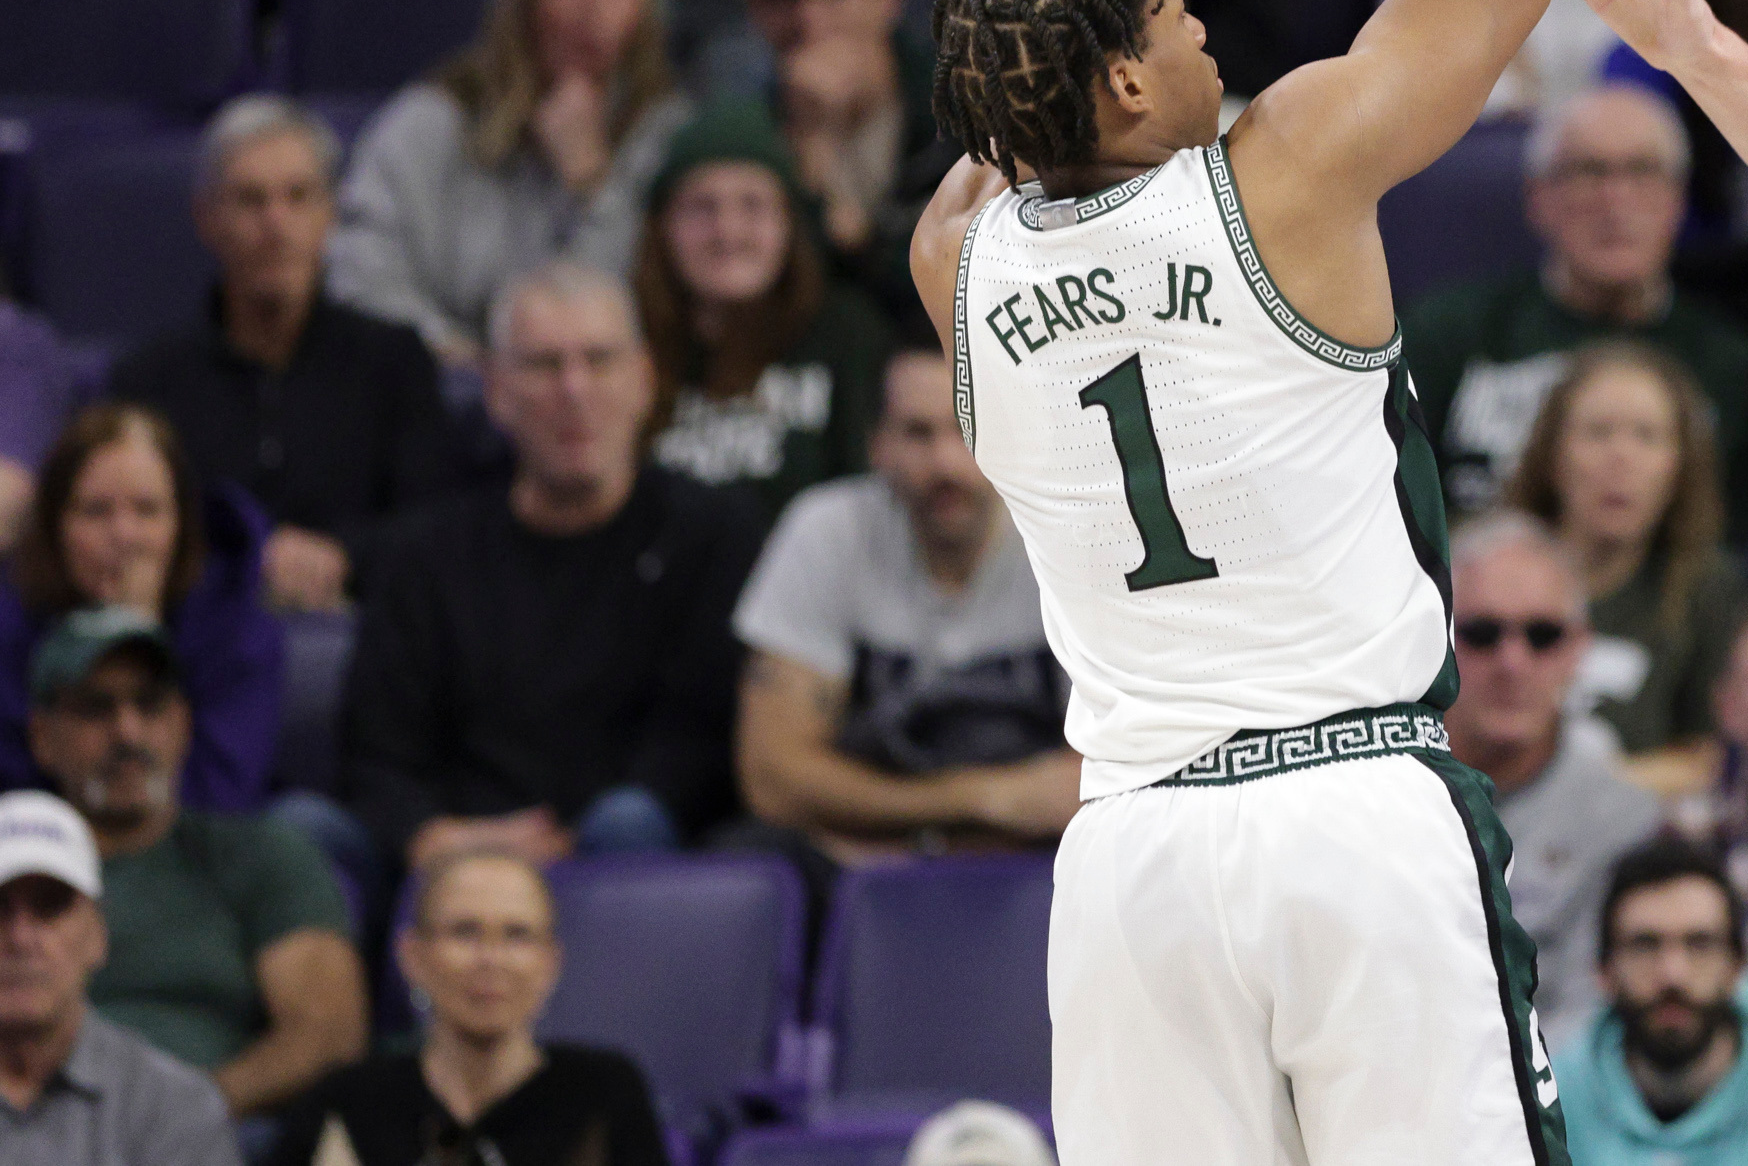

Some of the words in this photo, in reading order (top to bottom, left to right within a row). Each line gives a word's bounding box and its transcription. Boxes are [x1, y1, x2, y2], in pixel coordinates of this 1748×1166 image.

[985, 267, 1126, 366] FEARS
[1152, 262, 1222, 327] JR.
[1078, 352, 1219, 592] 1
